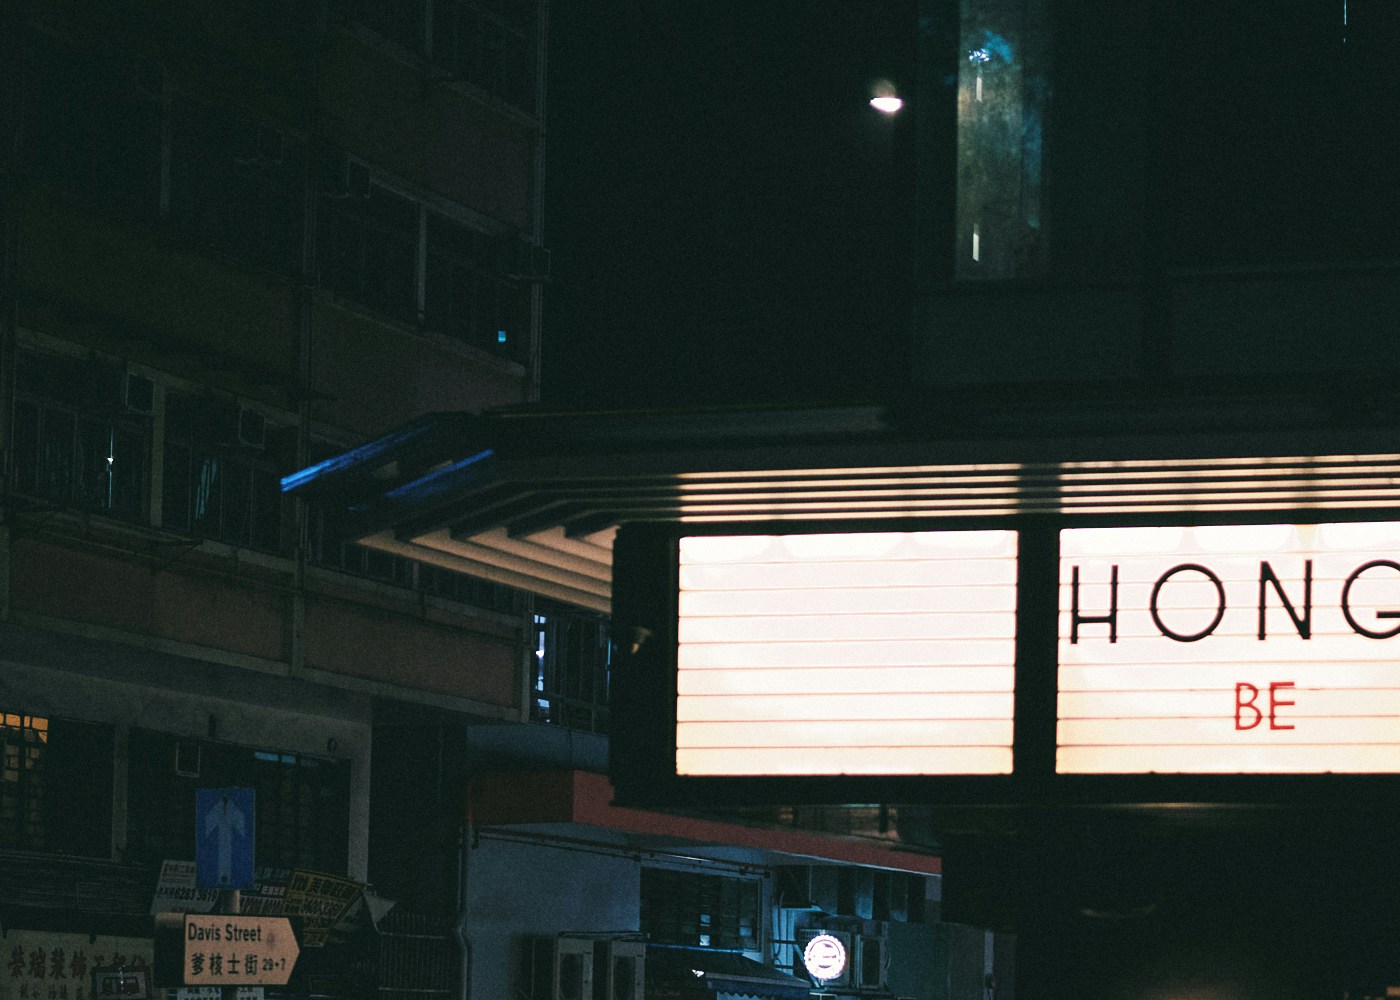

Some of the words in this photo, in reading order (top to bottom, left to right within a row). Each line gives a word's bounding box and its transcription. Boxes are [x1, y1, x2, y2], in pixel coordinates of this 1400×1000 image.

[1234, 681, 1296, 730] BE
[188, 923, 221, 942] Davis
[225, 924, 262, 942] Street
